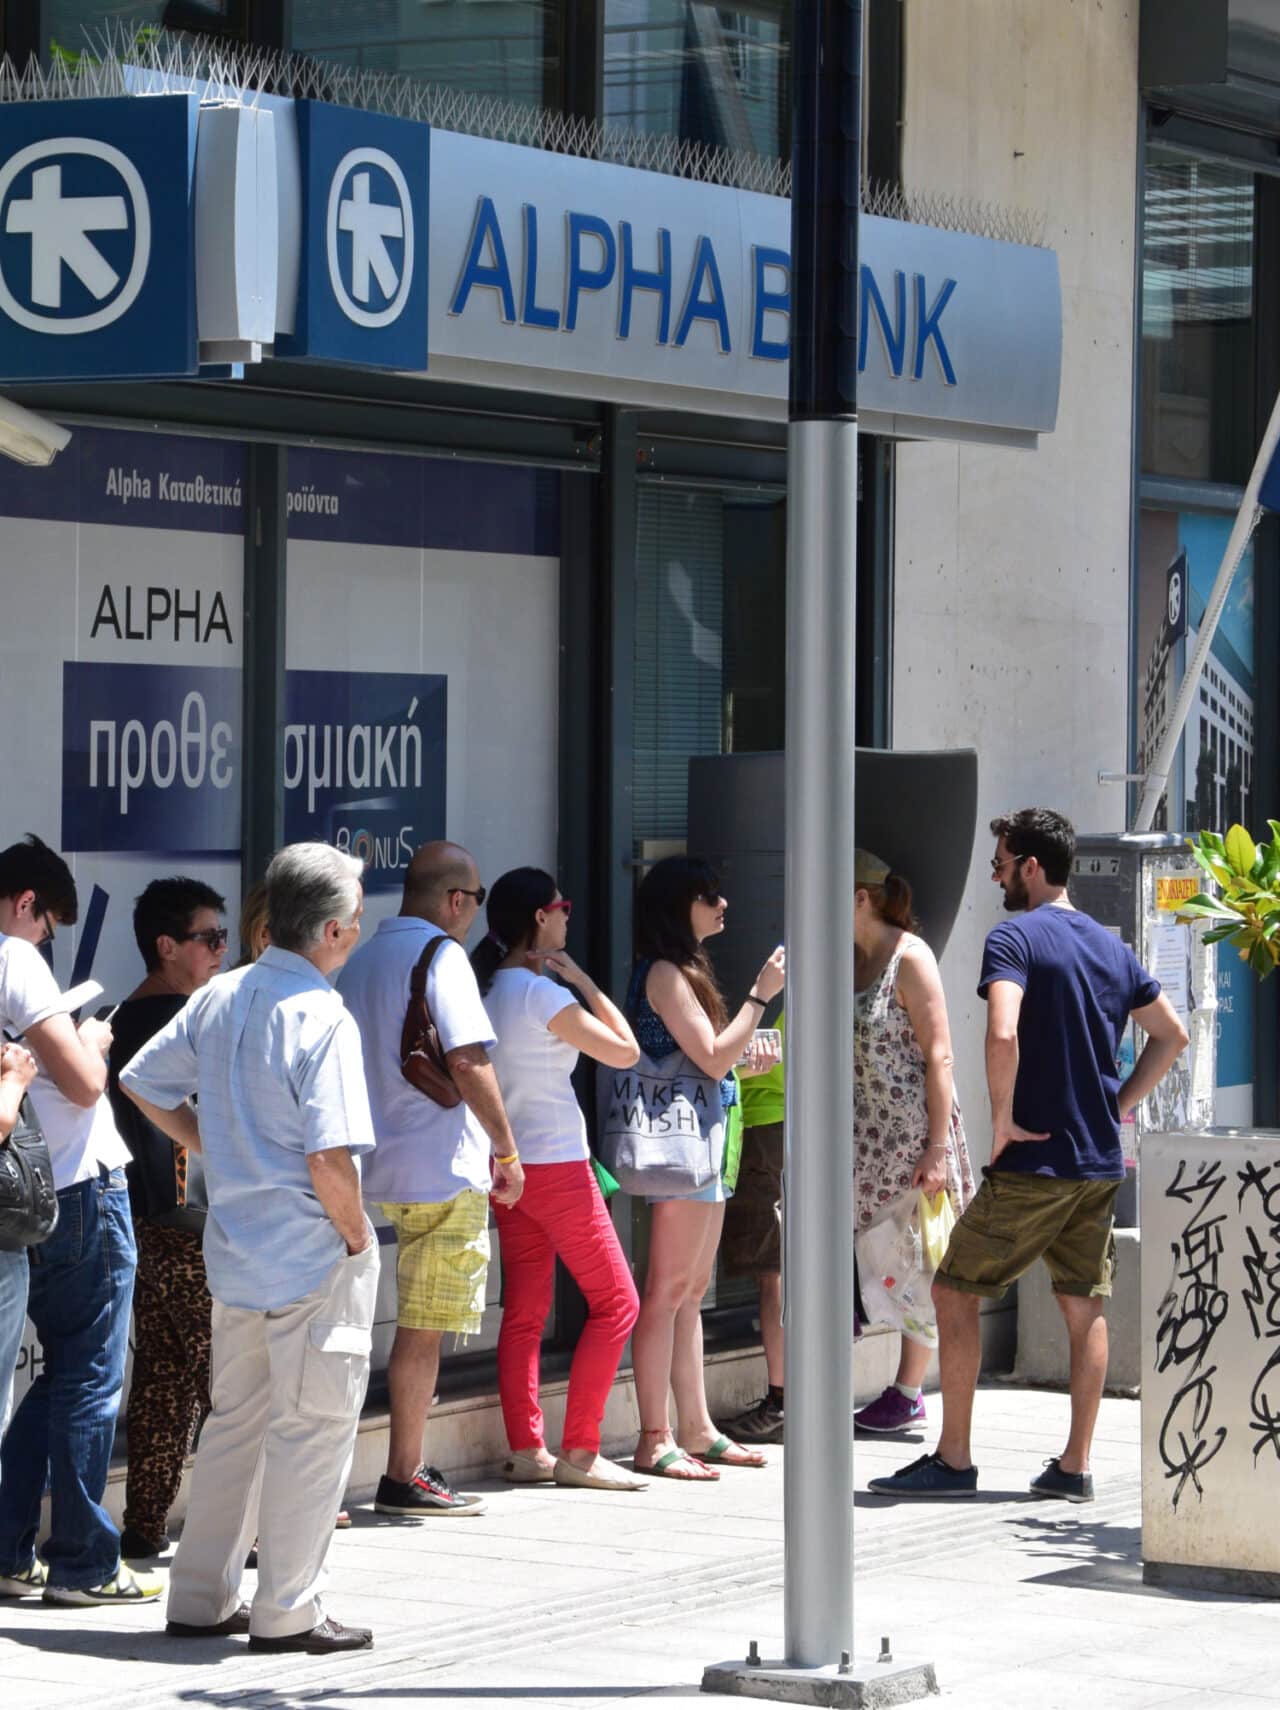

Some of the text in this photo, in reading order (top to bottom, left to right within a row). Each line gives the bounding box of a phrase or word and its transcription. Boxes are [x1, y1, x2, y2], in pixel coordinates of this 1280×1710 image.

[447, 194, 958, 386] ALPHA BNK
[106, 467, 339, 517] Alpha Καταθετικά ροϊόντα
[90, 584, 233, 643] ALPHA
[613, 1077, 708, 1107] MAKE A
[622, 1103, 695, 1134] WISH
